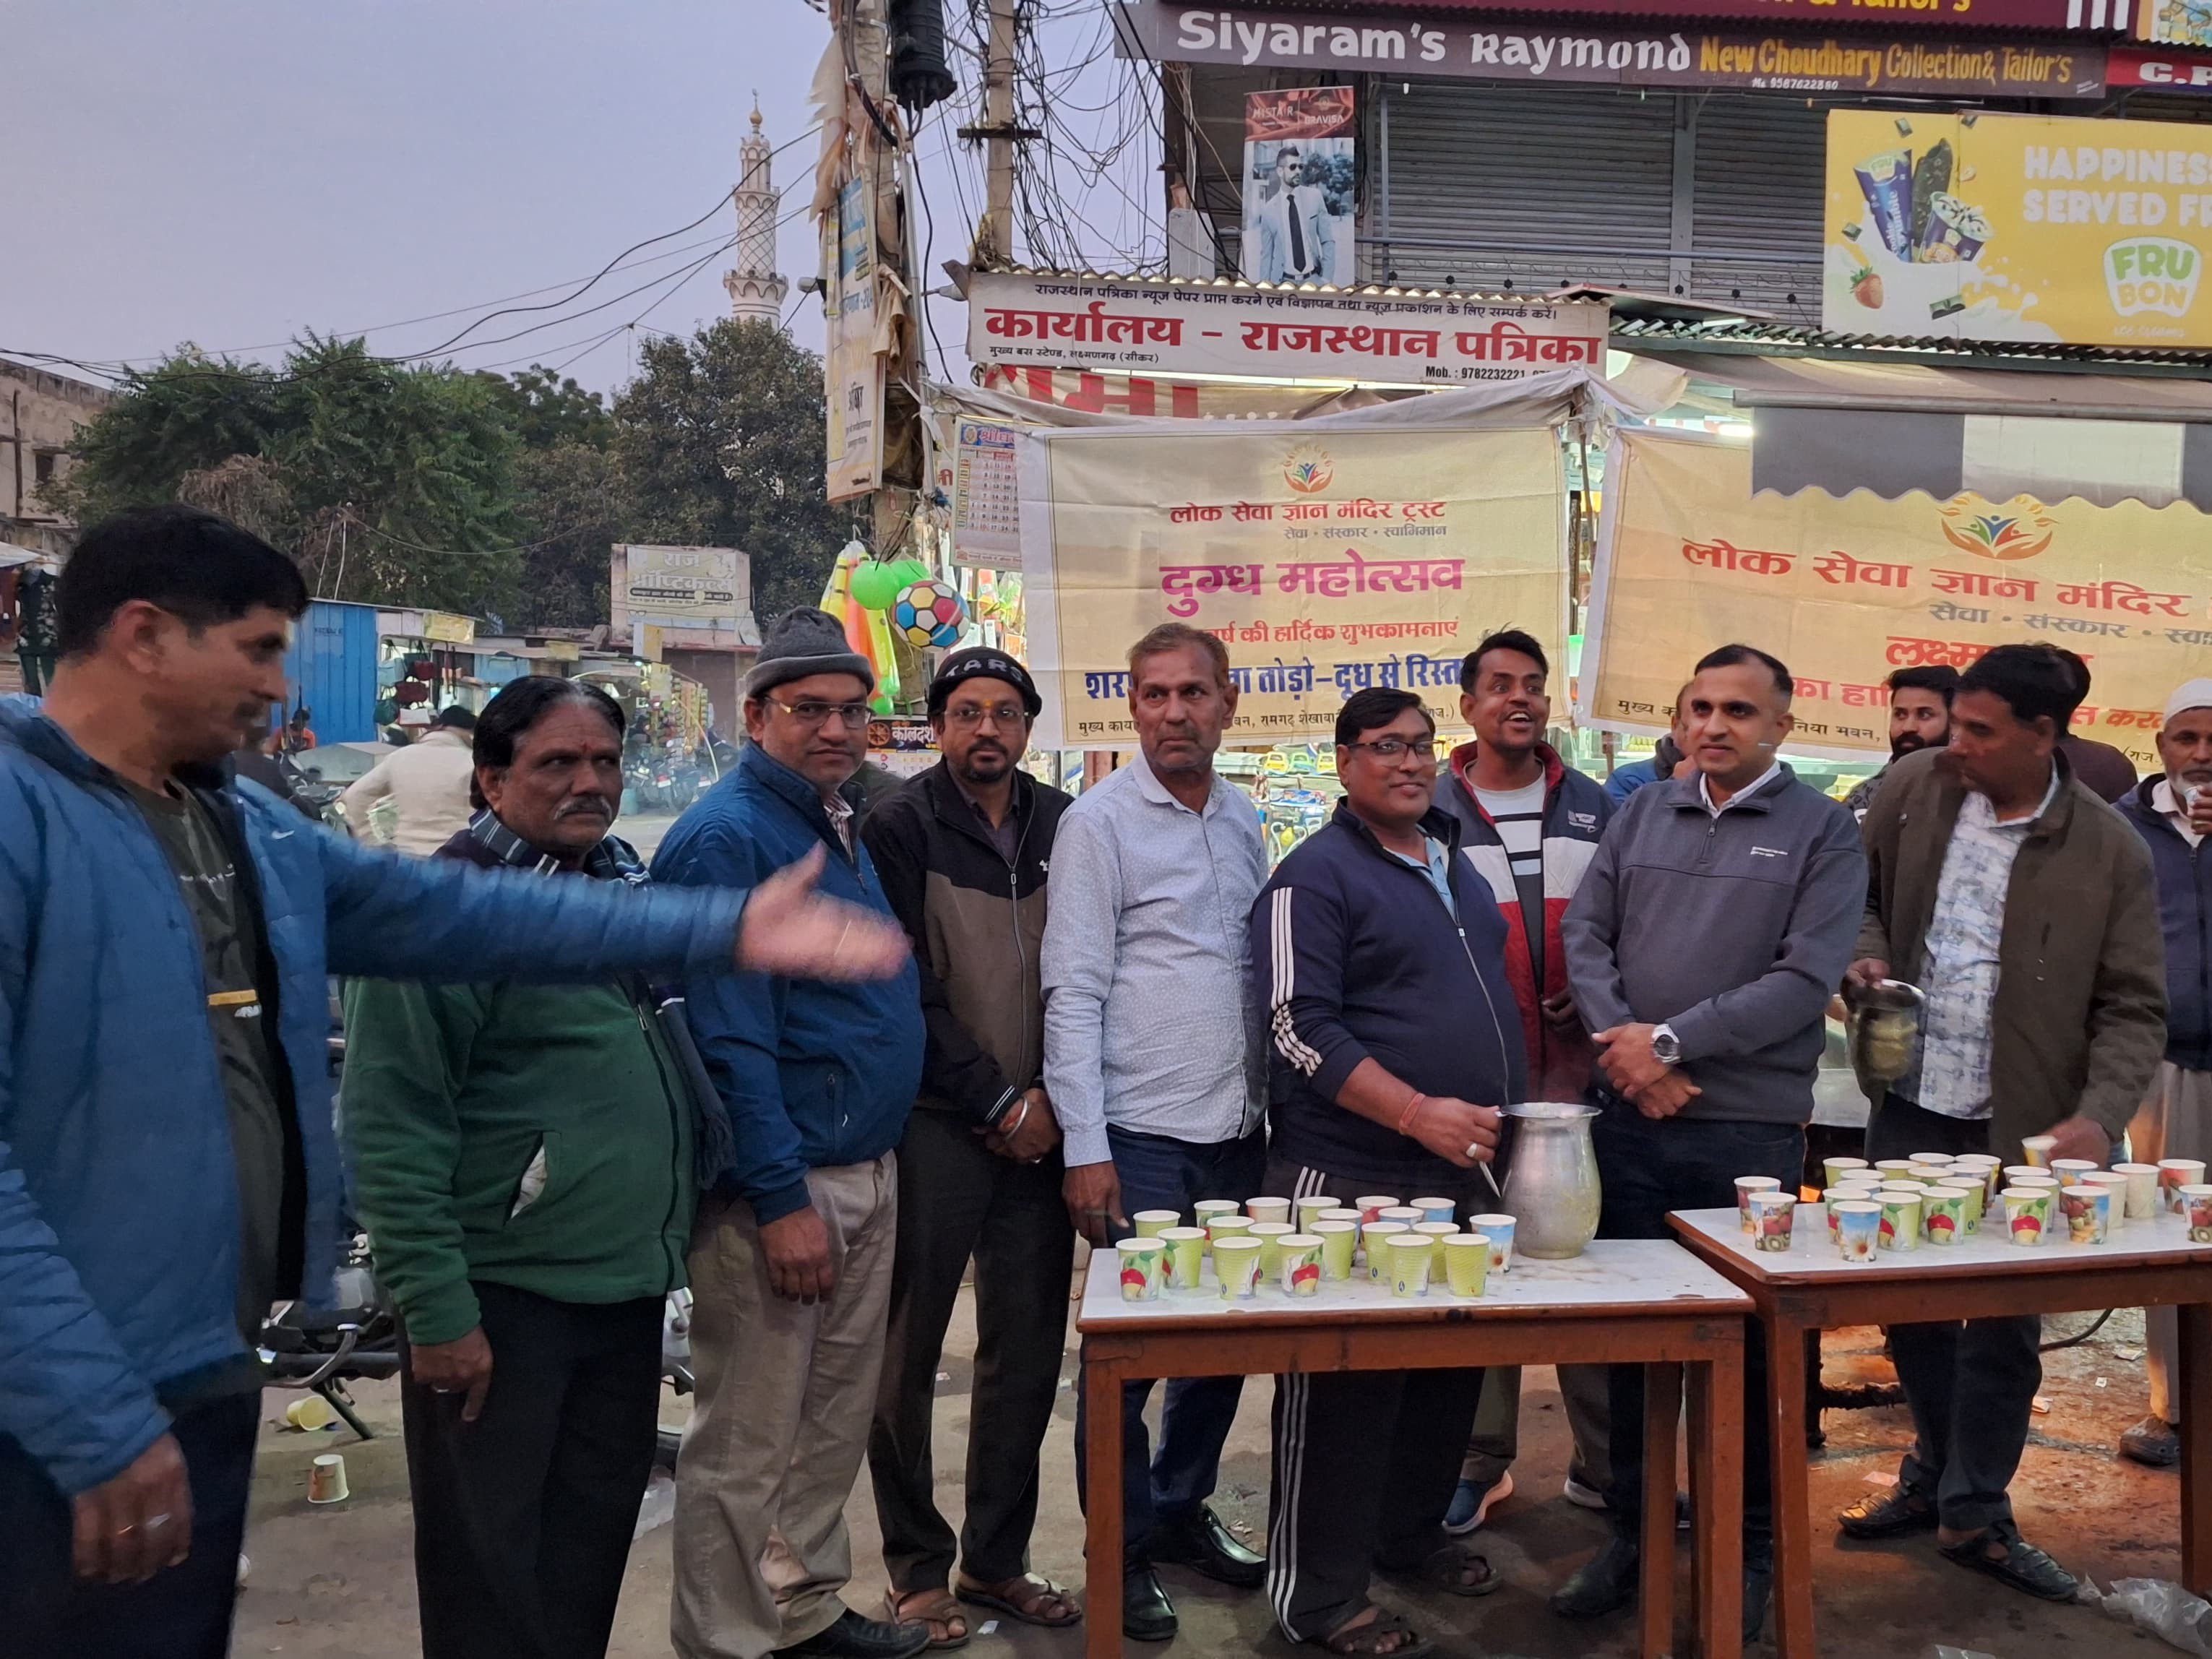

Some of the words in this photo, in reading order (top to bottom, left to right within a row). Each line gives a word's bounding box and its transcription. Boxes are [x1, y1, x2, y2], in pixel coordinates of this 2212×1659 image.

[1177, 10, 1446, 65] Siyaram's
[1470, 33, 1690, 74] Raymond
[1700, 36, 1756, 73] New
[1759, 38, 1882, 87] Choudhary
[2001, 46, 2073, 83] Tailor's
[2024, 146, 2212, 185] HAPPINES
[2023, 189, 2167, 226] SERVED
[2112, 244, 2195, 281] FRU
[1035, 284, 1093, 297] राजस्थान
[1097, 284, 1137, 300] पत्रिका
[1142, 289, 1169, 305] न्यूज
[1174, 288, 1200, 302] पेपर
[1203, 293, 1228, 304] प्राप्त
[1231, 292, 1262, 306] करने
[1266, 293, 1284, 309] एवं
[1288, 294, 1333, 309] विज्ञापन
[1338, 300, 1361, 311] तथा
[1447, 301, 1460, 314] के
[1463, 303, 1486, 317] लिए
[1489, 304, 1528, 318] सम्पर्क
[2117, 281, 2187, 309] BON
[984, 301, 1184, 346] कार्यालय
[1239, 322, 1441, 358] राजस्थान
[1454, 321, 1602, 365] पत्रिका
[989, 345, 1013, 357] मुख्य
[1016, 348, 1033, 356] बस
[1119, 352, 1159, 363] (सीकर)
[1461, 367, 1525, 380] 9782232221
[1170, 501, 1223, 523] लोक
[1231, 501, 1273, 523] सेवा
[1281, 503, 1329, 521] ज्ञान
[1336, 498, 1393, 520] मंदिर
[1401, 501, 1447, 522] ट्रस्ट
[1283, 525, 1308, 540] सेवा
[1322, 525, 1369, 540] संस्कार
[1382, 524, 1447, 538] स्वाभिमान
[1159, 564, 1265, 618] दुग्ध
[1276, 548, 1466, 598] महोत्सव
[1682, 537, 1797, 575] लोक
[1812, 551, 1914, 588] सेवा
[1929, 569, 2040, 602] ज्ञान
[2056, 580, 2192, 616] मंदिर
[1239, 621, 1270, 643] की
[1274, 619, 1335, 642] हार्दिक
[1340, 616, 1460, 645] शुभकामनाएं
[1929, 601, 1991, 624] सेवा
[2023, 613, 2131, 639] संस्कार
[1378, 654, 1401, 689] से
[1617, 699, 1655, 716] मुख्य
[1079, 721, 1104, 736] मुख्य
[1836, 725, 1880, 742] भवन,
